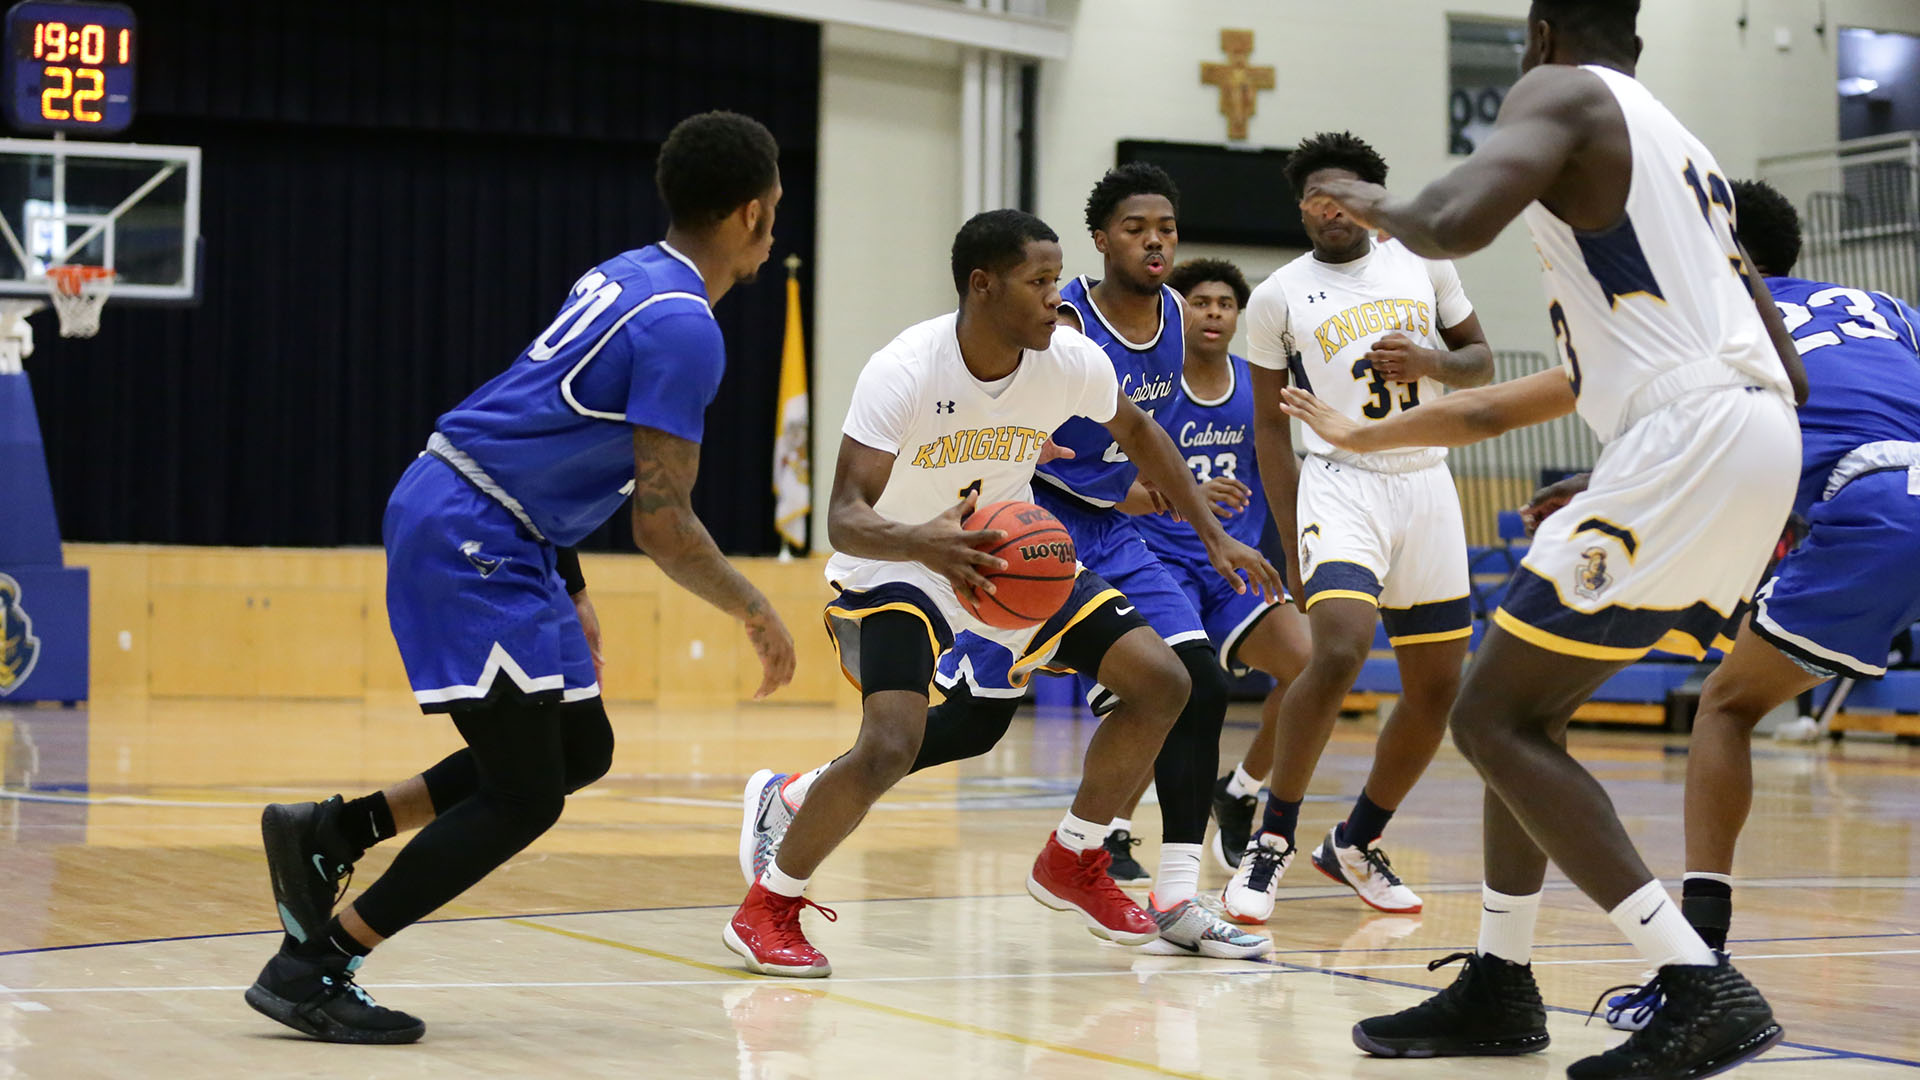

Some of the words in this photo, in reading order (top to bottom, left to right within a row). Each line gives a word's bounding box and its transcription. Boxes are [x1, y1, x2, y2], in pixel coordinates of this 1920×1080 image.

[33, 22, 129, 64] 19:01
[42, 66, 104, 122] 22
[1313, 298, 1430, 364] KNIGHTS
[1773, 287, 1899, 357] 23
[1121, 371, 1174, 404] Cabrini
[1179, 420, 1246, 448] Cabrini
[1186, 452, 1238, 484] 33
